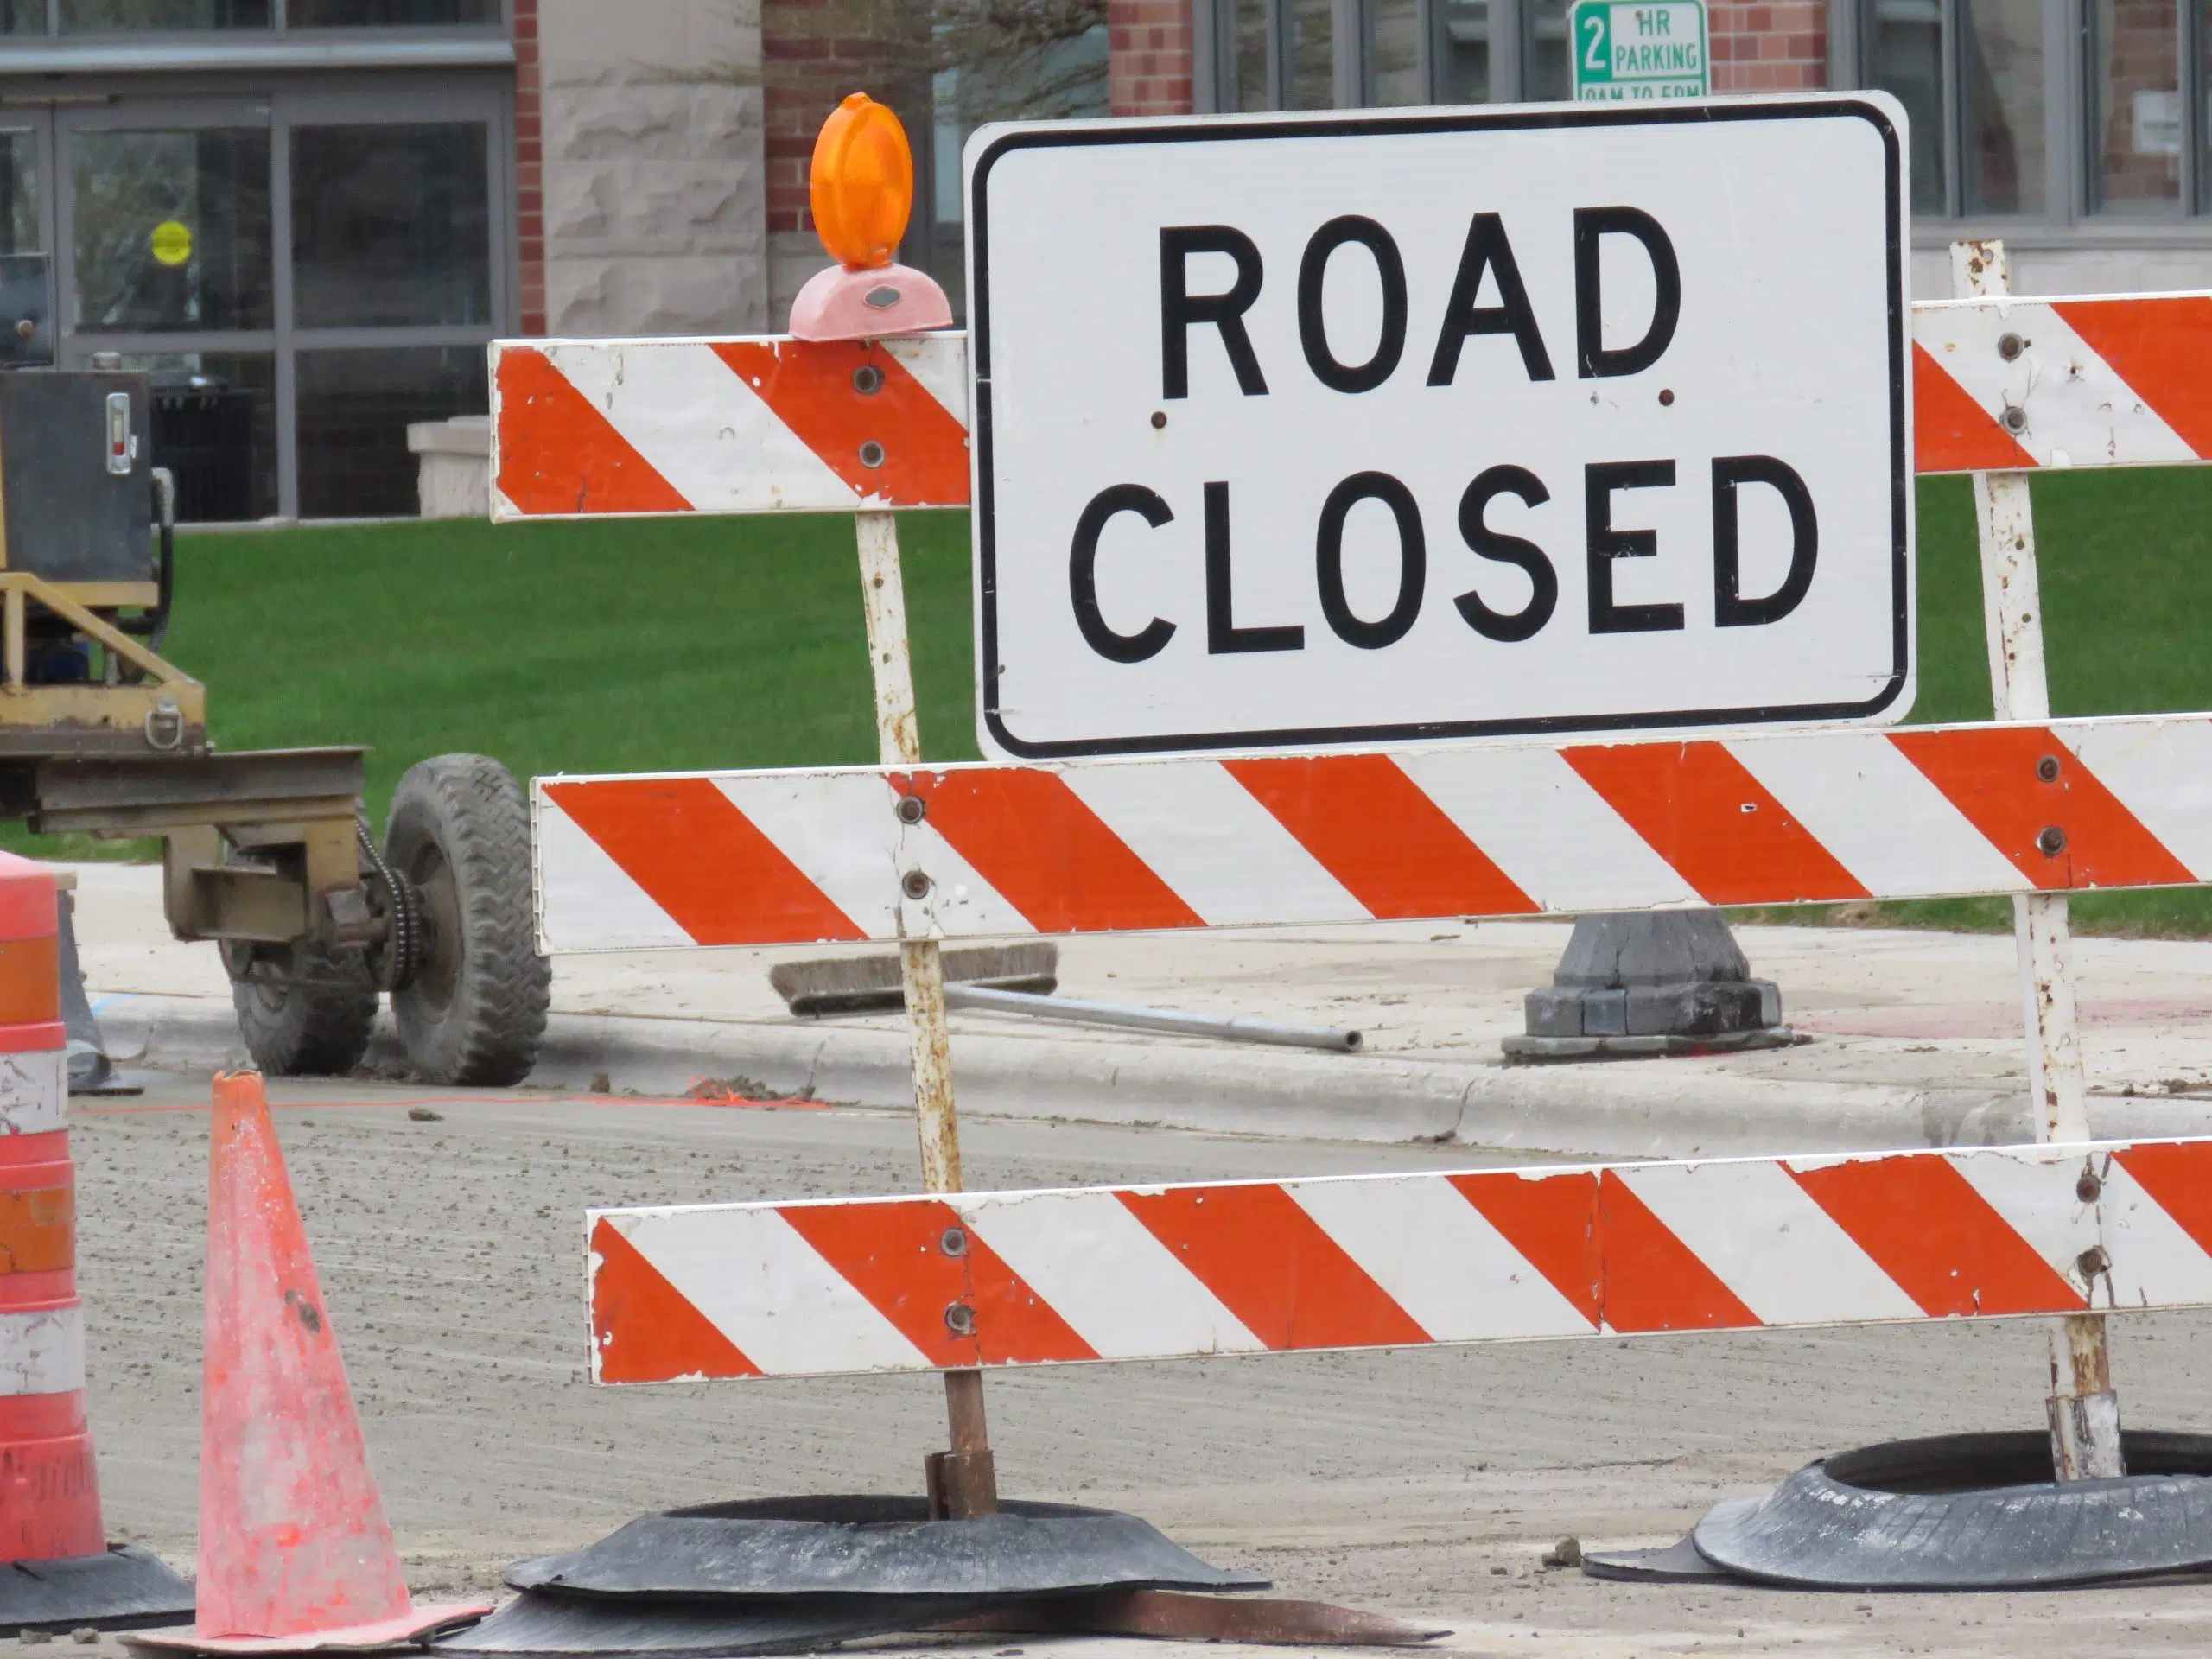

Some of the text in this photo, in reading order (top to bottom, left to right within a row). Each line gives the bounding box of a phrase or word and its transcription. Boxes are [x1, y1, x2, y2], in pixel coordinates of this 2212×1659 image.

[1584, 9, 1671, 70] 2 HR
[1615, 43, 1698, 72] PARKING
[1160, 206, 1682, 400] ROAD
[1069, 455, 1820, 664] CLOSED
